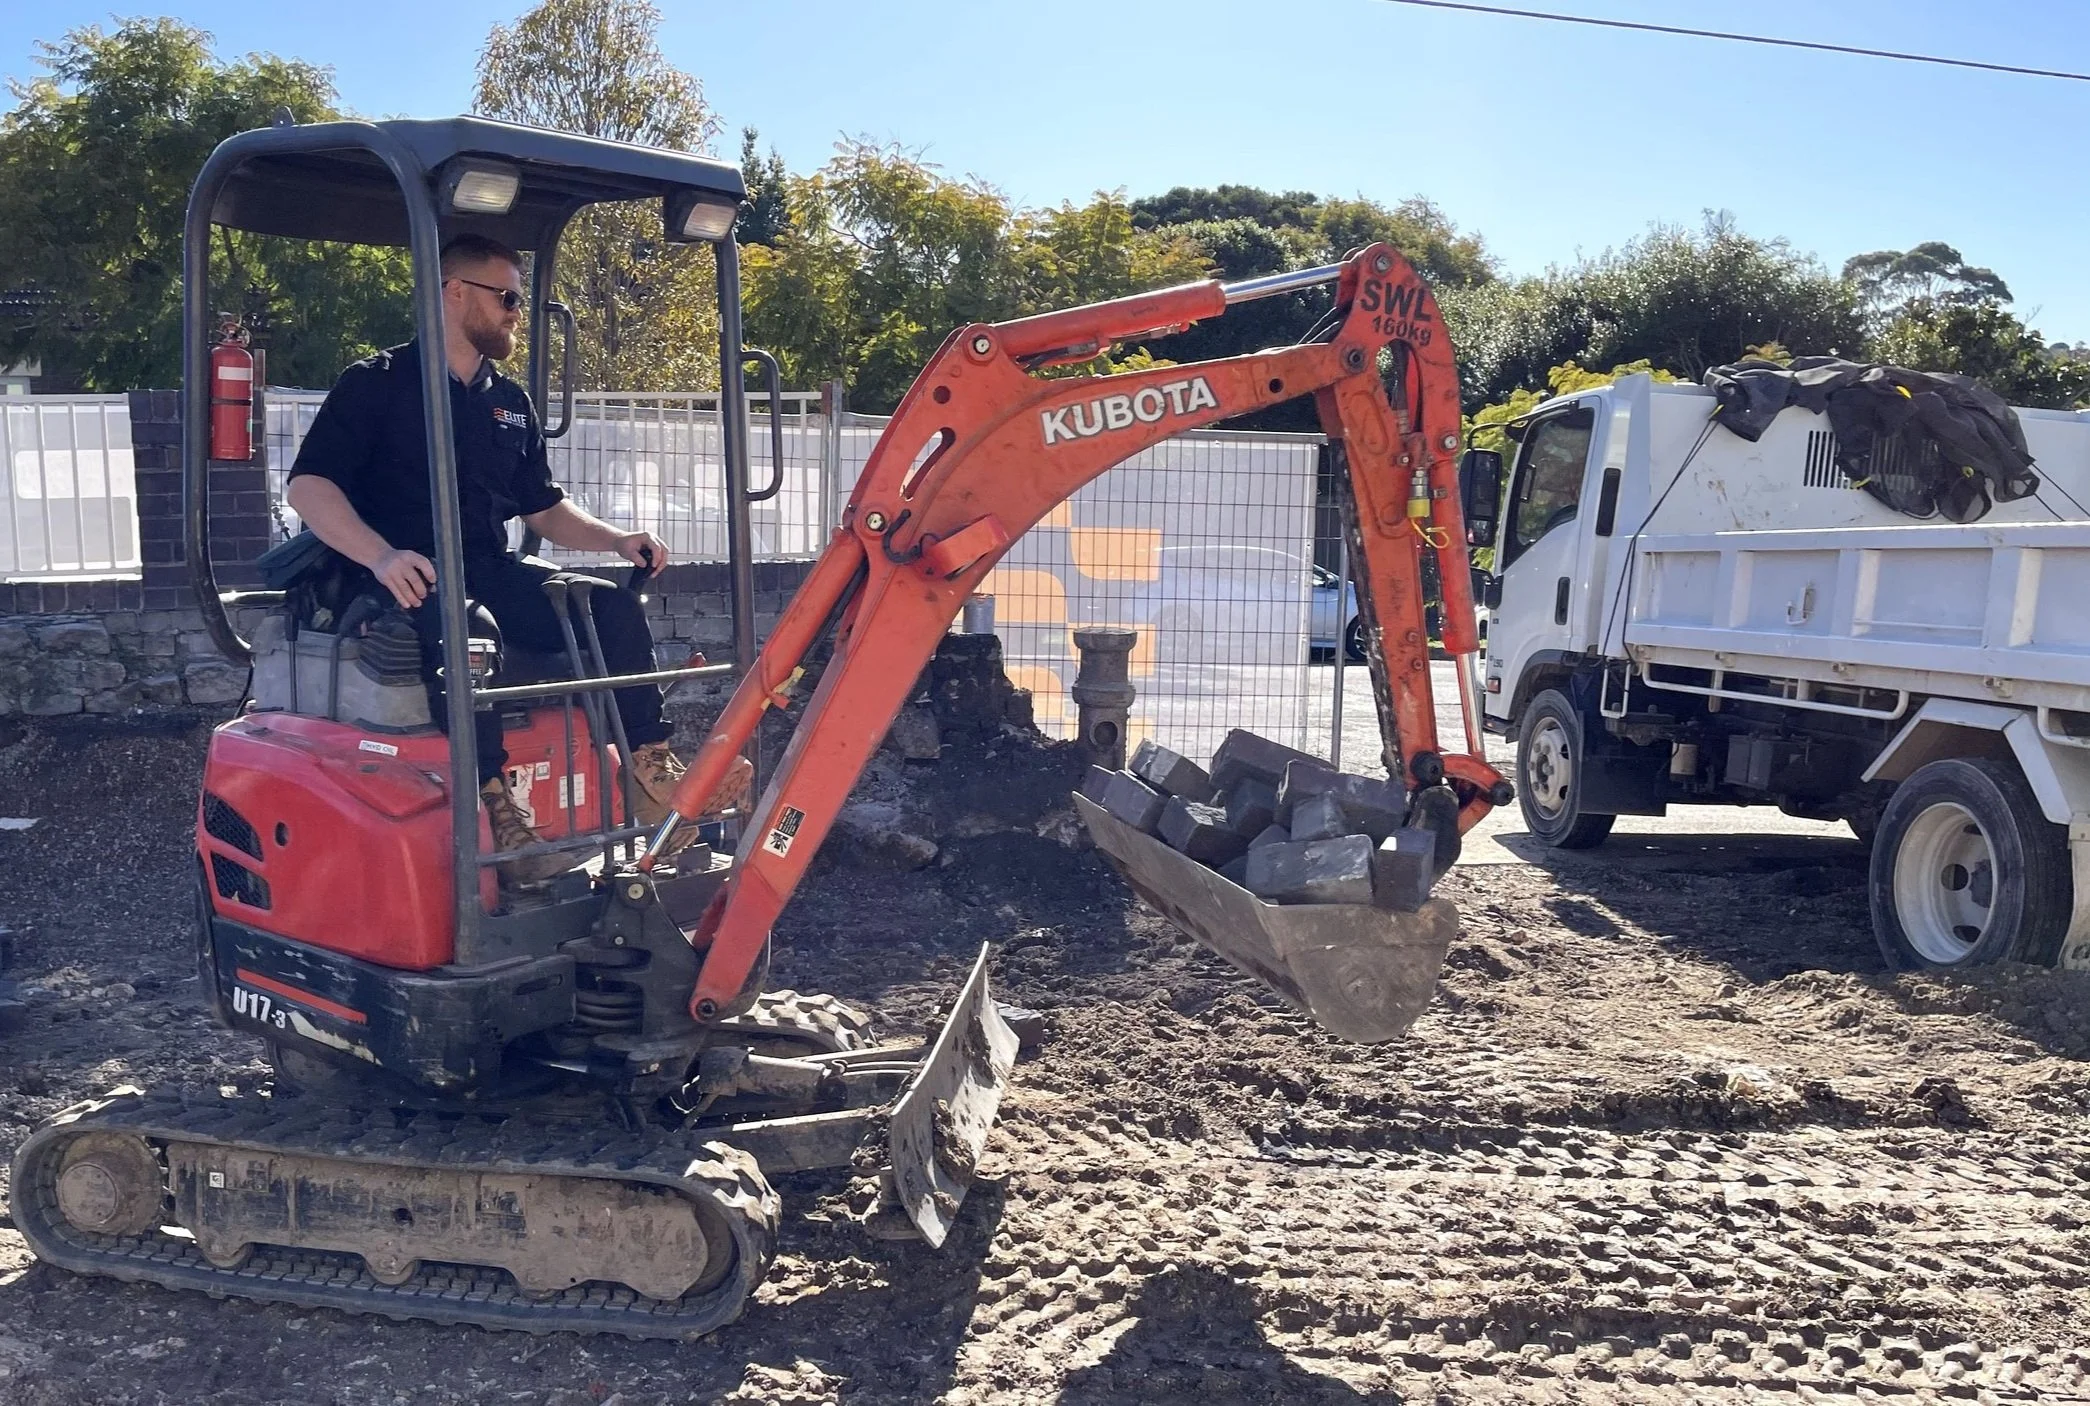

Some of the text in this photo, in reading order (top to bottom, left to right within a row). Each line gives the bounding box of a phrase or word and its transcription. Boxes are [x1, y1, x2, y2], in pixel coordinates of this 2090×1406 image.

[1360, 277, 1432, 322] SWL
[1372, 315, 1433, 347] 160kg
[503, 409, 528, 426] ELITE
[1040, 376, 1218, 445] KUBOTA
[232, 986, 287, 1029] U17-3
